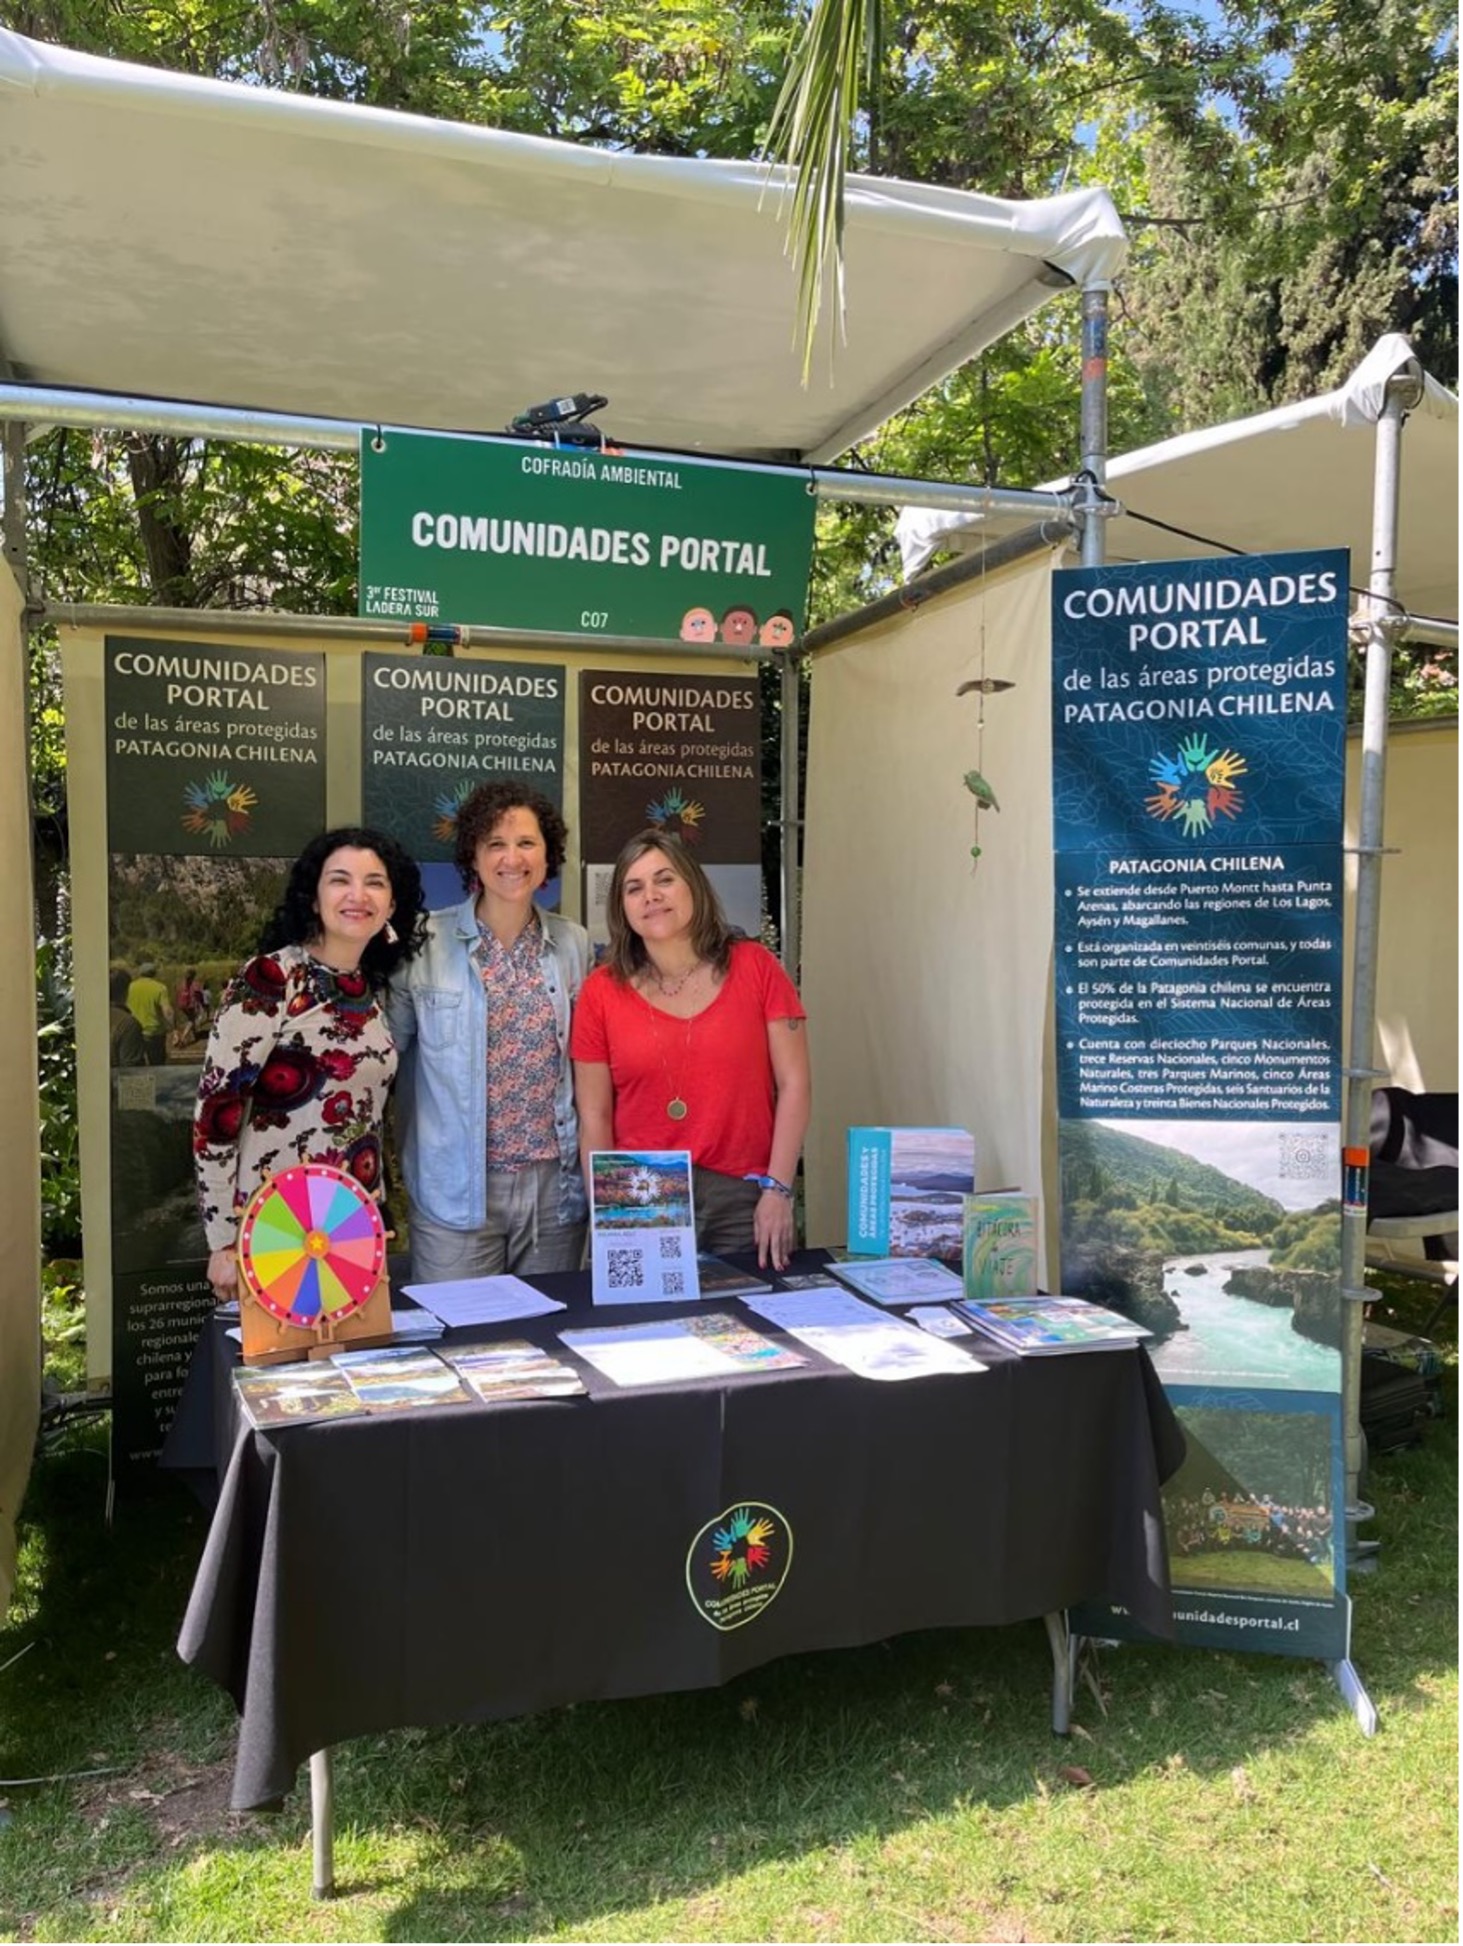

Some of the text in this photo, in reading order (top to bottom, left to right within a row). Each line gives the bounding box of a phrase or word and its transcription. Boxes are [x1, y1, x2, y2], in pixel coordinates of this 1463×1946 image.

[521, 456, 683, 490] COFRADÍA AMBIENTAL
[411, 511, 772, 577] COMUNIDADES PORTAL
[384, 587, 439, 604] FESTIVAL
[1063, 571, 1338, 619] COMUNIDADES
[366, 600, 439, 617] LADERA SUR
[1129, 616, 1267, 652] PORTAL
[113, 652, 317, 688] COMUNIDADES
[1063, 655, 1335, 691] de las áreas protegidas
[373, 667, 559, 698] COMUNIDADES
[167, 684, 270, 710] PORTAL
[591, 685, 754, 709] COMUNIDADES
[421, 697, 514, 722] PORTAL
[1064, 691, 1335, 724] PATAGONIA CHILENA
[114, 711, 318, 742] de las áreas protegidas
[633, 711, 715, 732] PORTAL
[372, 724, 557, 751] de las áreas protegidas
[115, 738, 318, 764] PATAGONIA CHILENA
[591, 737, 754, 760] de las áreas protegidas
[373, 750, 556, 773] PATAGONIA CHILENA
[591, 761, 754, 778] PATAGONIA CHILENA
[1109, 856, 1285, 874] PATAGONIA CHILENA
[1077, 880, 1332, 896] Se extiende desde Puerto Montt hasta Punta
[1122, 899, 1181, 911] abarcando
[1184, 899, 1200, 909] las
[1203, 898, 1251, 911] regiones
[1254, 897, 1270, 908] de
[1272, 897, 1292, 908] Los
[1077, 915, 1112, 928] Aysén
[1113, 918, 1120, 928] y
[1078, 941, 1101, 952] Está
[1102, 941, 1162, 955] organizada
[1164, 942, 1178, 951] en
[1180, 940, 1231, 951] veintiséis
[1290, 941, 1297, 952] y
[1299, 938, 1332, 949] todas
[1078, 954, 1269, 969] son parte de Comunidades Portal.
[1078, 981, 1331, 997] El 50% de la Patagonia chilena se encuentra
[1079, 995, 1331, 1011] protegida en el Sistema Nacional de Áreas
[1079, 1013, 1139, 1026] Protegidas.
[1079, 1038, 1120, 1049] Cuenta
[1124, 1040, 1146, 1049] con
[1150, 1038, 1207, 1049] dieciocho
[1211, 1038, 1257, 1051] Parques
[1080, 1054, 1106, 1064] trece
[1108, 1052, 1154, 1064] Reservas
[1221, 1054, 1251, 1064] cinco
[1254, 1054, 1331, 1064] Monumentos
[1138, 1069, 1158, 1079] tres
[1162, 1068, 1206, 1081] Parques
[1262, 1069, 1295, 1080] cinco
[1298, 1067, 1331, 1079] Áreas
[1080, 1082, 1118, 1093] Marino
[1120, 1082, 1164, 1093] Costeras
[1225, 1084, 1244, 1094] seis
[1246, 1083, 1302, 1094] Santuarios
[1304, 1083, 1319, 1094] de
[1320, 1084, 1330, 1094] la
[1080, 1097, 1329, 1112] Naturaleza y treinta Bienes Nacionales Protegidos.
[139, 1280, 210, 1296] Somos una
[127, 1319, 146, 1332] los
[149, 1318, 165, 1330] 26
[136, 1353, 182, 1366] chilena
[144, 1370, 173, 1386] para
